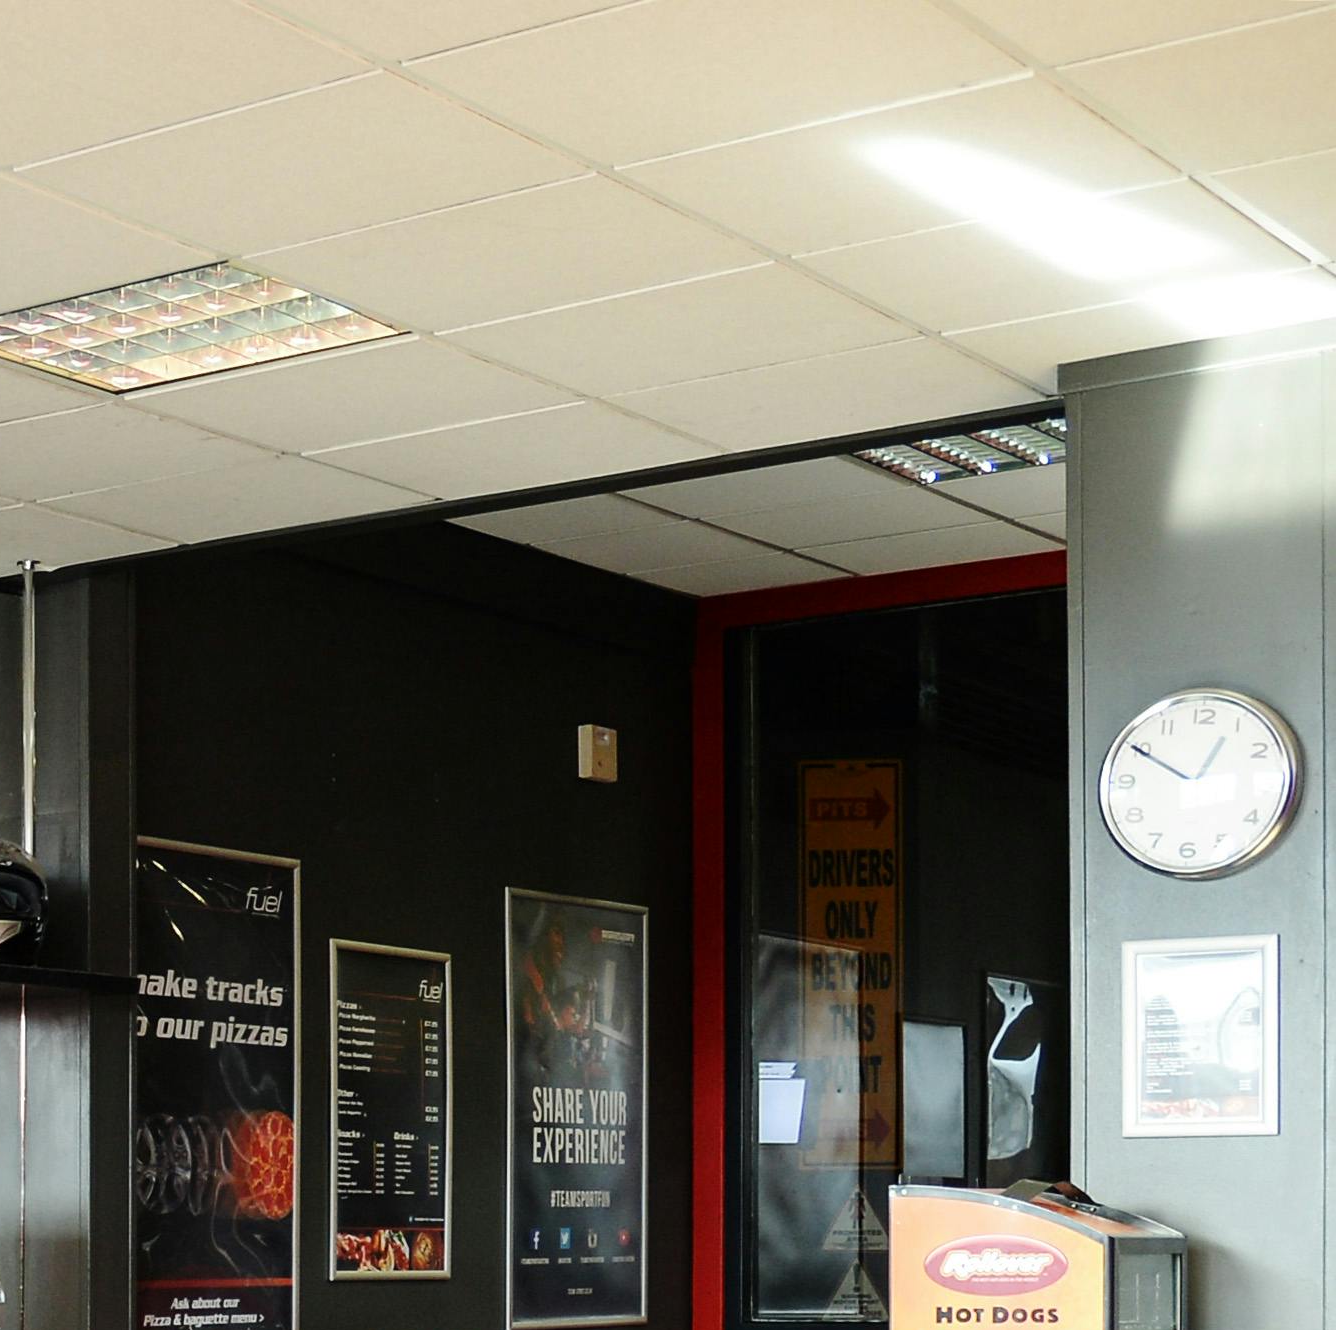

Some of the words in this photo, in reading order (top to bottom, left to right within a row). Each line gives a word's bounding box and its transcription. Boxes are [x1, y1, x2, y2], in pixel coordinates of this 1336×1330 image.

[1193, 708, 1216, 724] 12
[1161, 719, 1173, 735] 11
[1235, 718, 1240, 733] 1
[1251, 743, 1269, 759] 2
[1118, 774, 1136, 789] 9
[1125, 807, 1145, 823] 8
[1243, 809, 1259, 825] 4
[1148, 833, 1163, 849] 7
[1179, 842, 1196, 859] 6
[809, 849, 894, 888] DRIVERS
[246, 887, 282, 913] fuel
[825, 901, 877, 939] ONLY
[812, 952, 892, 992] BEYOND
[206, 976, 284, 1007] tracks
[419, 980, 443, 1000] fuel
[137, 1015, 149, 1037] o
[156, 1017, 205, 1041] our
[209, 1016, 289, 1050] pizzas
[533, 1087, 584, 1124] SHARE
[589, 1089, 627, 1126] YOUR
[532, 1127, 626, 1164] EXPERIENCE
[171, 1298, 189, 1310] Ask
[192, 1297, 221, 1309] about
[223, 1299, 241, 1308] our
[143, 1315, 171, 1327] Pizza
[183, 1314, 229, 1328] baguette
[231, 1314, 258, 1324] menu
[936, 1306, 984, 1323] HOT
[992, 1306, 1059, 1323] DOGS
